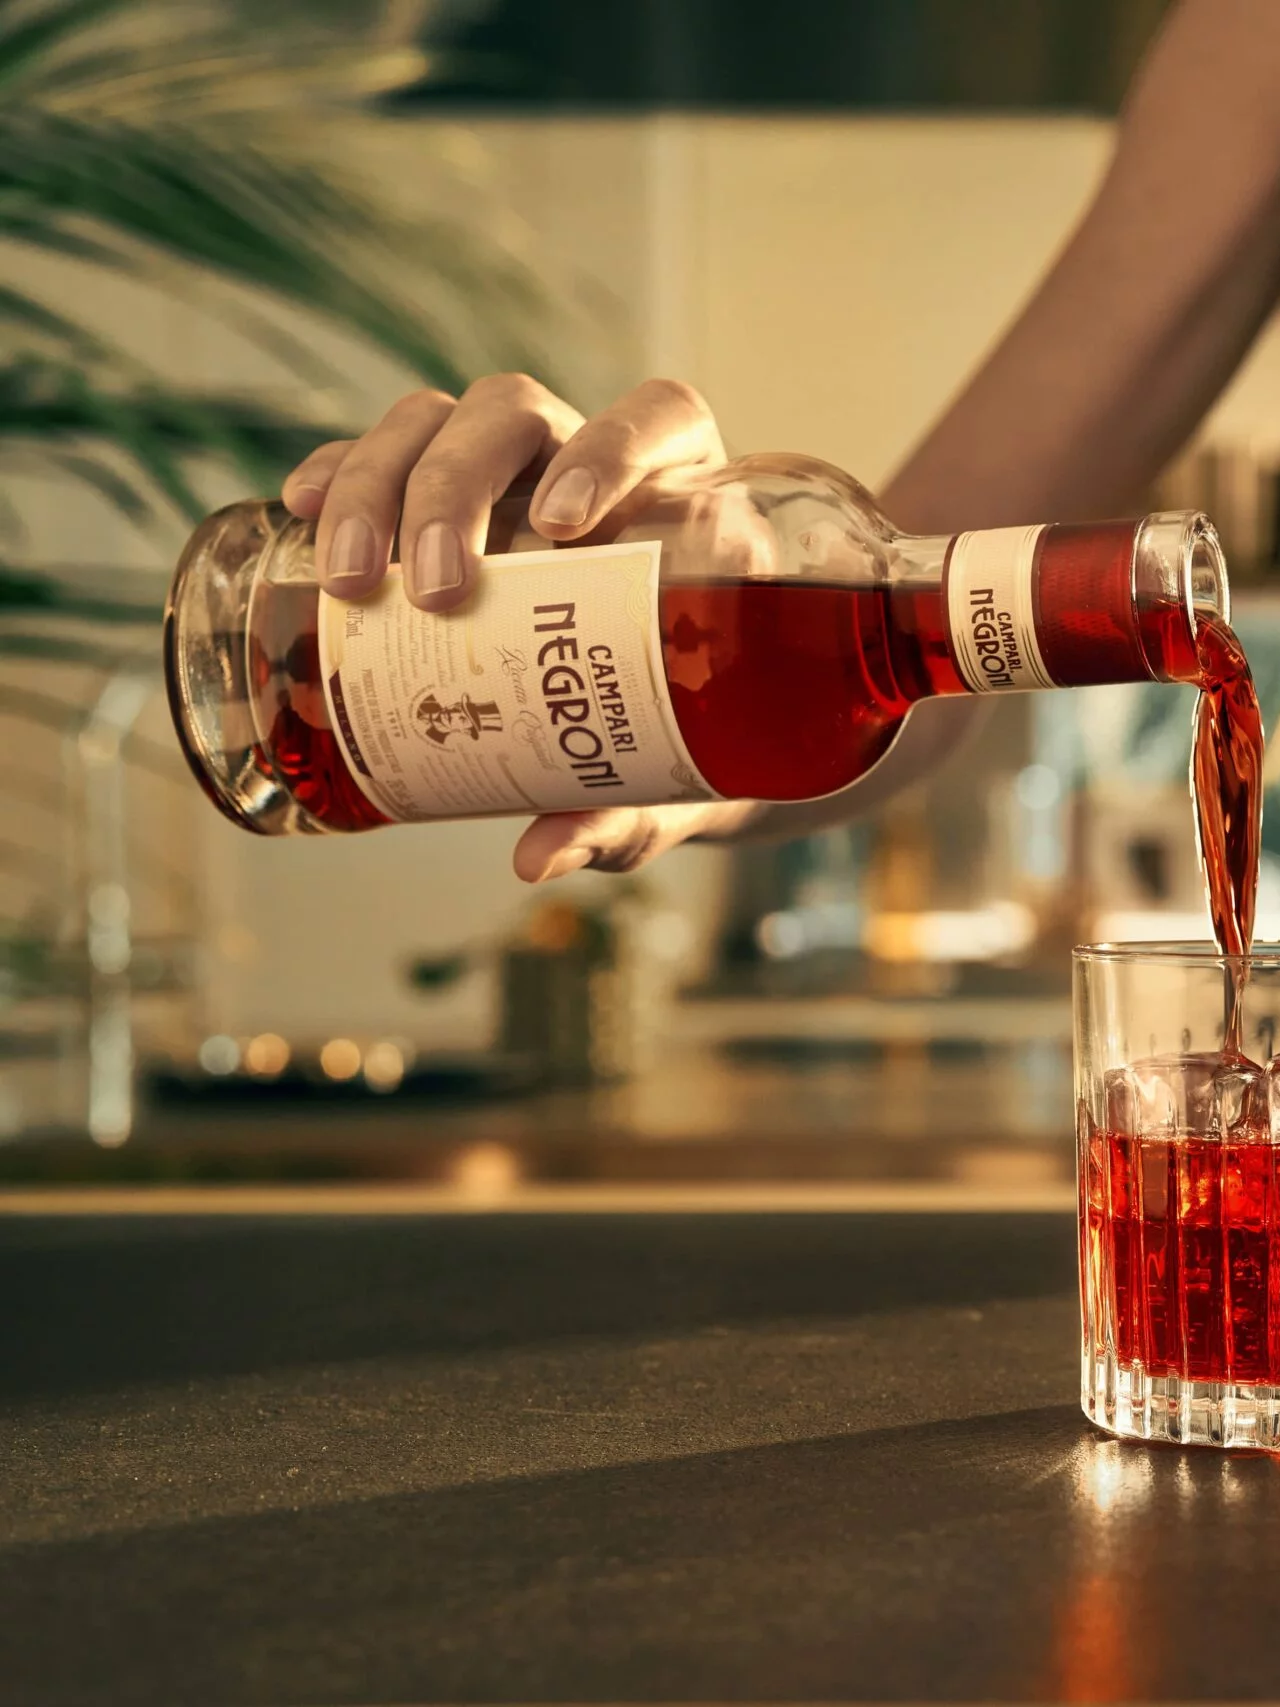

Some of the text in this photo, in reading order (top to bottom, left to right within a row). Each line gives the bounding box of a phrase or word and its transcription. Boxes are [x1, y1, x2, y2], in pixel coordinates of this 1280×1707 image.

[346, 608, 363, 639] 375mL
[970, 589, 1015, 687] NEGRONI
[997, 612, 1022, 670] CAMPARI
[334, 695, 361, 762] MILANO
[387, 711, 401, 738] 1919
[534, 602, 624, 788] NEGRONI
[588, 645, 637, 753] CAMPARI
